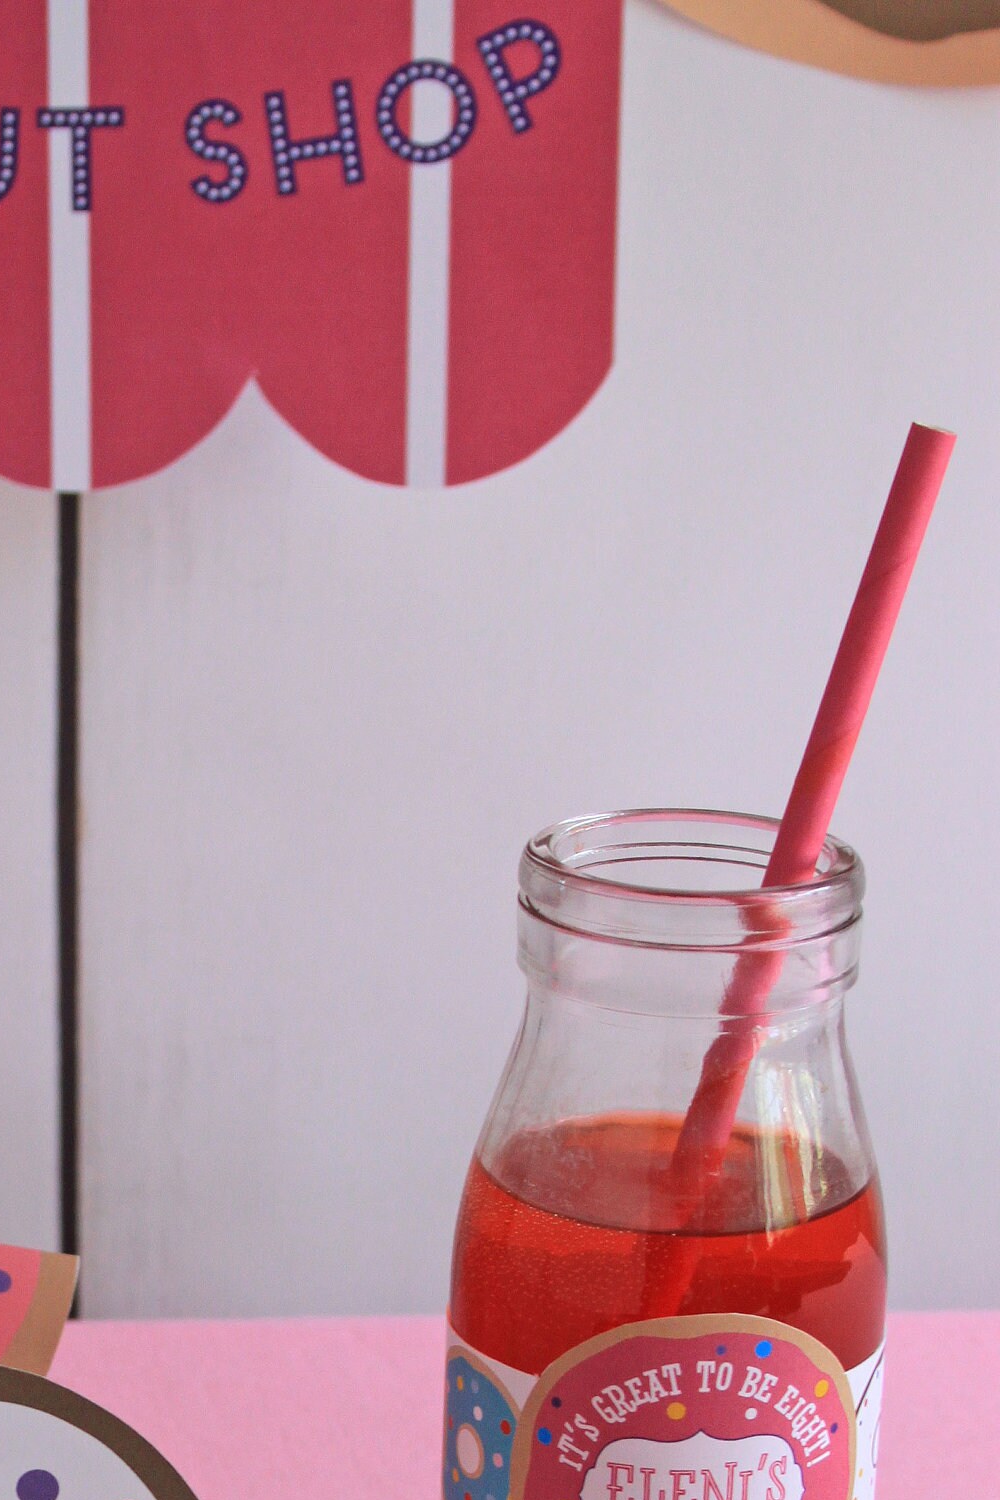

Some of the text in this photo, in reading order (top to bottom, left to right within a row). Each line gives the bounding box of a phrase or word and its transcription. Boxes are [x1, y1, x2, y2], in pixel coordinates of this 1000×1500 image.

[183, 17, 562, 204] SHOP
[557, 1360, 831, 1472] IT'S GREAT TO BE EIGHT!
